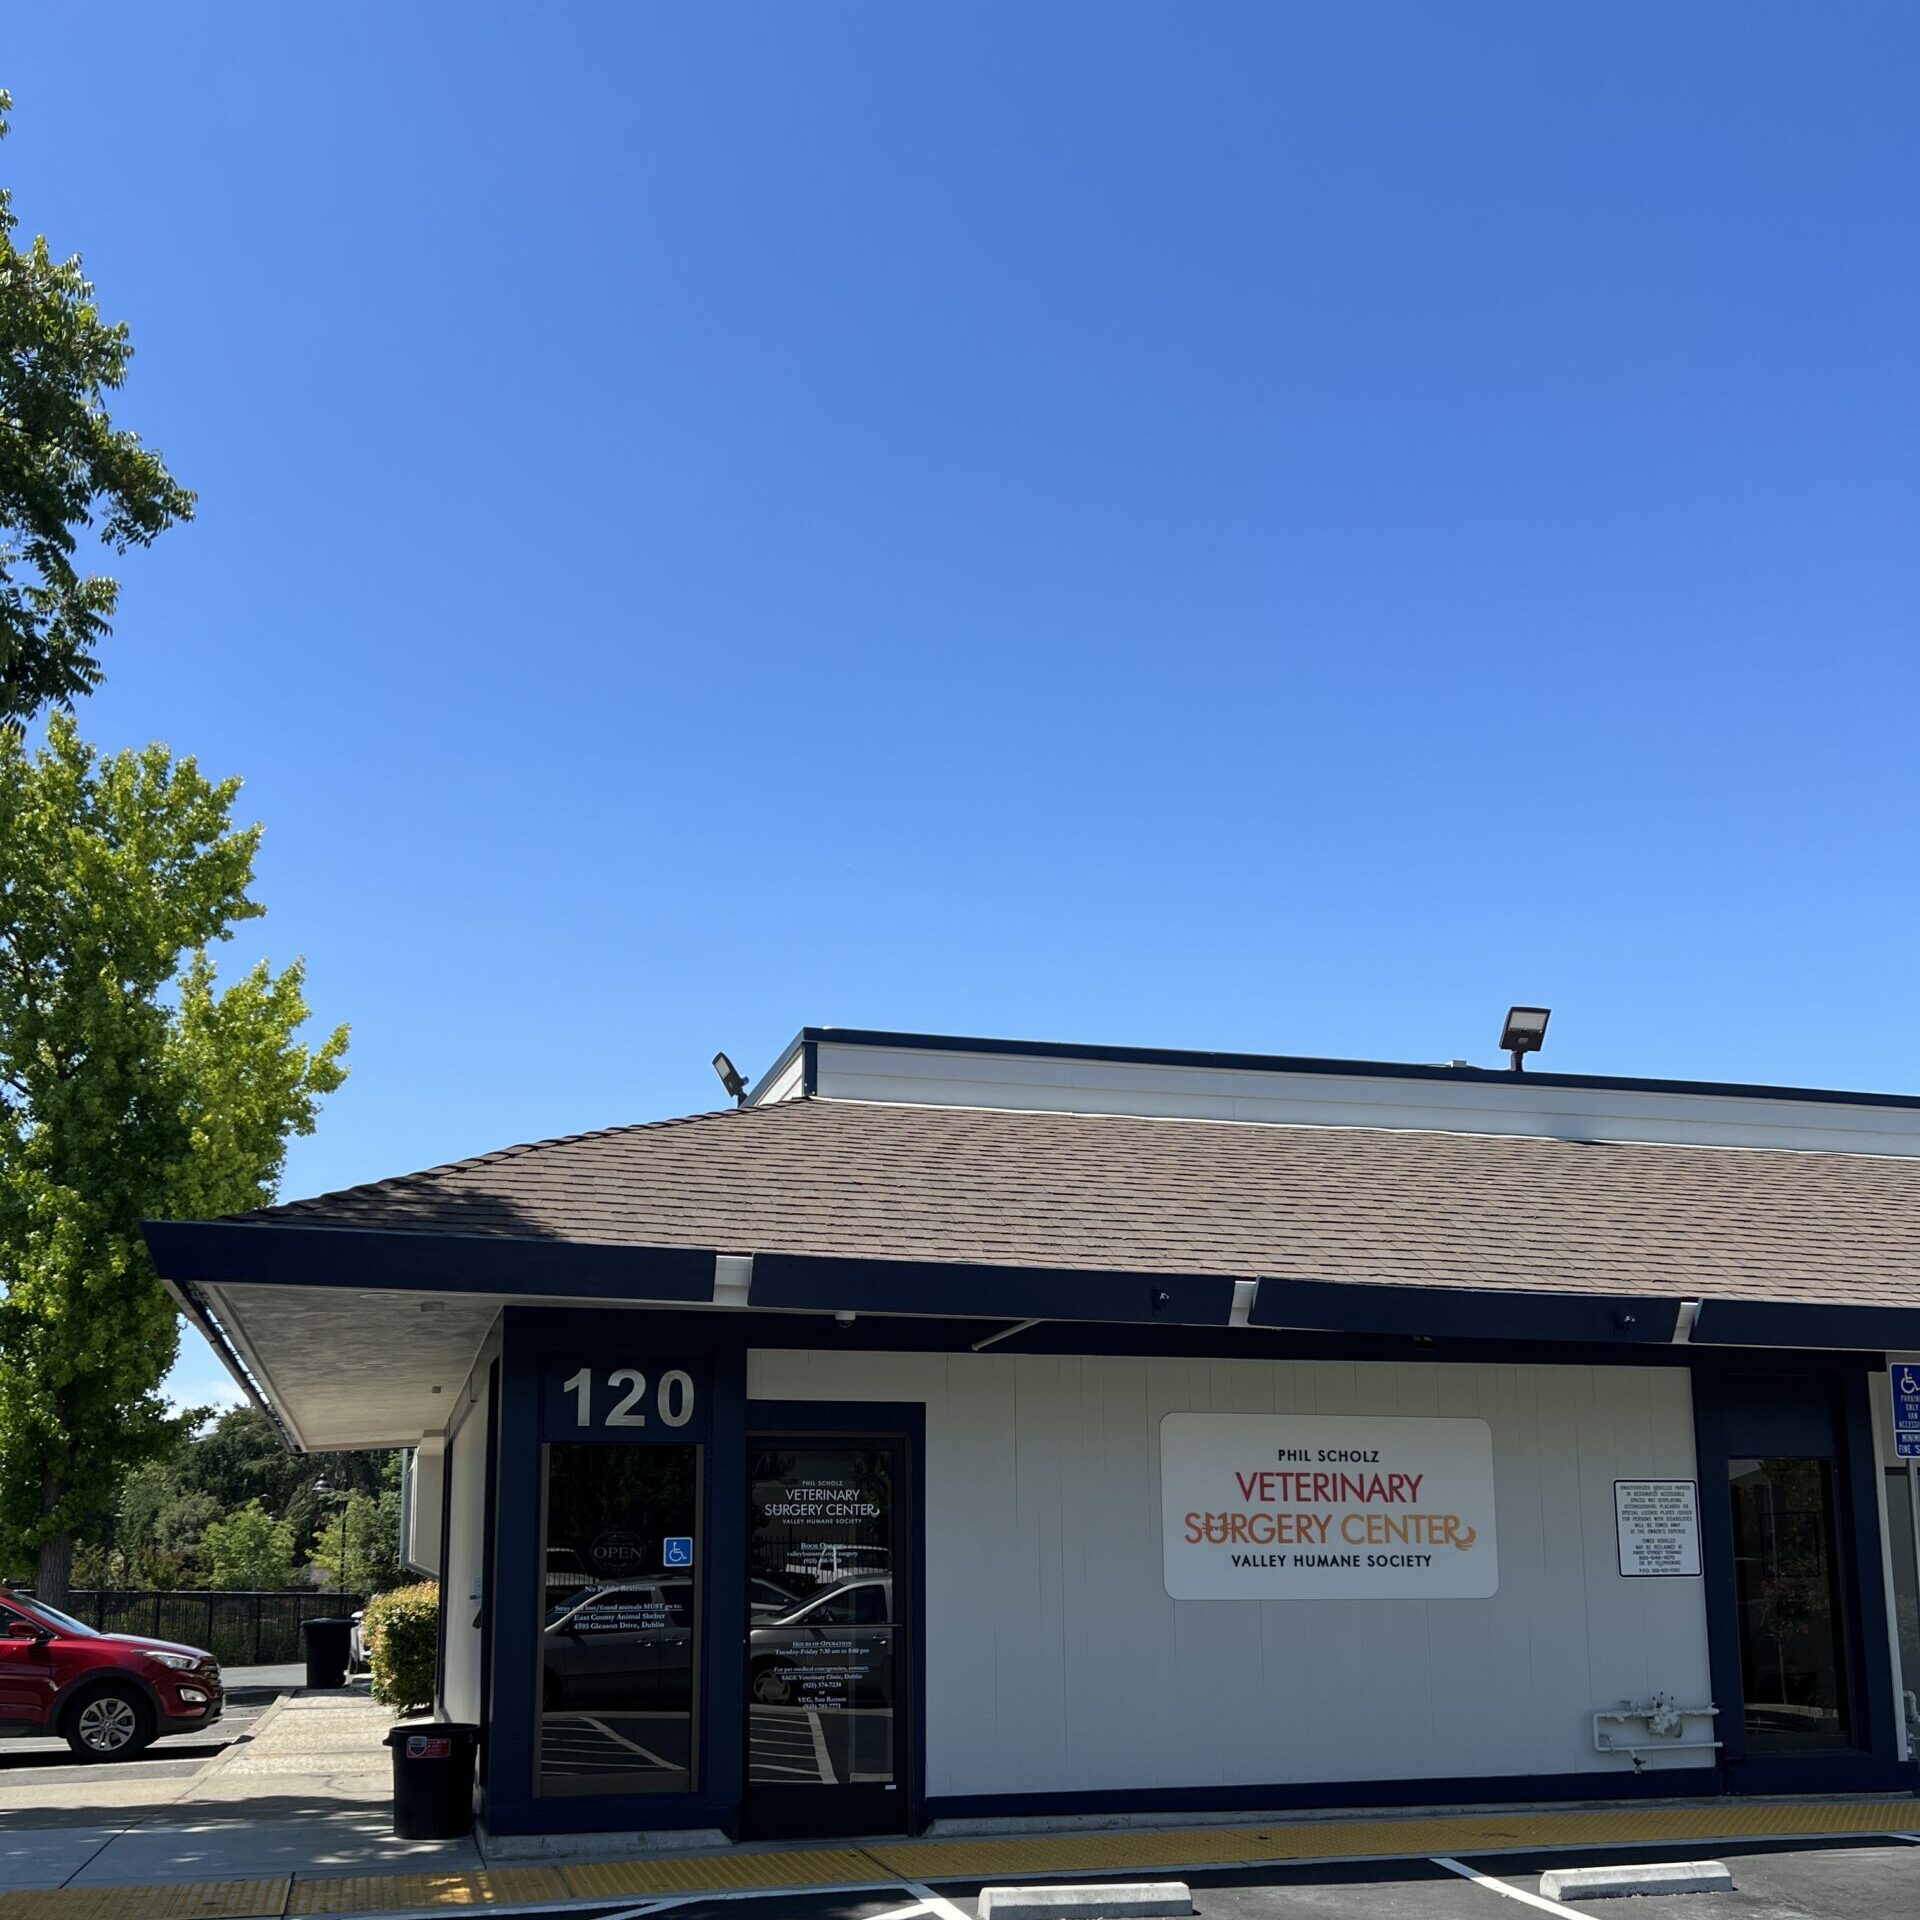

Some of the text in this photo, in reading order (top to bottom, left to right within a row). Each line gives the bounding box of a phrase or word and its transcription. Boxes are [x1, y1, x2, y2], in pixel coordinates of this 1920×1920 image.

[563, 1368, 694, 1427] 120
[1900, 1394, 1920, 1402] PARKIN
[1902, 1434, 1920, 1442] MINIM
[1898, 1444, 1911, 1454] FINE
[1278, 1449, 1380, 1463] PHIL SCHOLZ
[1235, 1472, 1423, 1503] VETERINARY
[786, 1489, 860, 1501] VETERINARY
[764, 1504, 880, 1518] SURGERY CENTER
[1184, 1512, 1476, 1551] SURGERY CENTER
[594, 1547, 642, 1559] OPEN
[1231, 1555, 1432, 1568] VALLEY HUMANE SOCIETY
[591, 1614, 615, 1622] County
